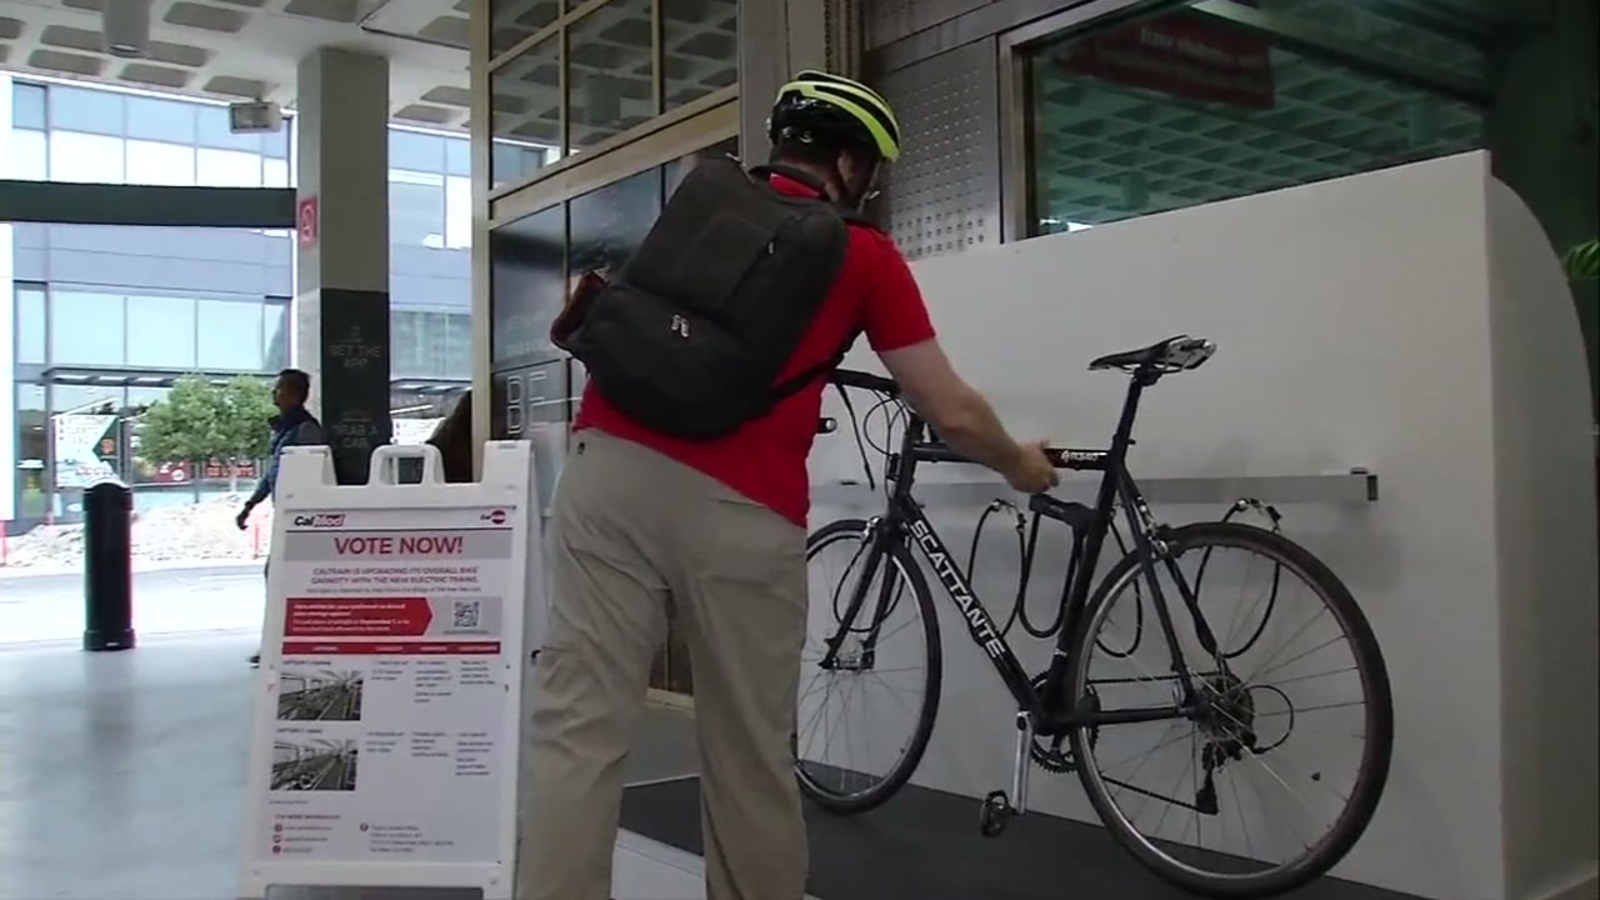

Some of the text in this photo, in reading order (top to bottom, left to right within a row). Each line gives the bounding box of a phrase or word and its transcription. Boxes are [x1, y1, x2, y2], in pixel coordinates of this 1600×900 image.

[334, 536, 463, 555] VOTE NOW!
[910, 519, 1006, 659] SCATTANTE
